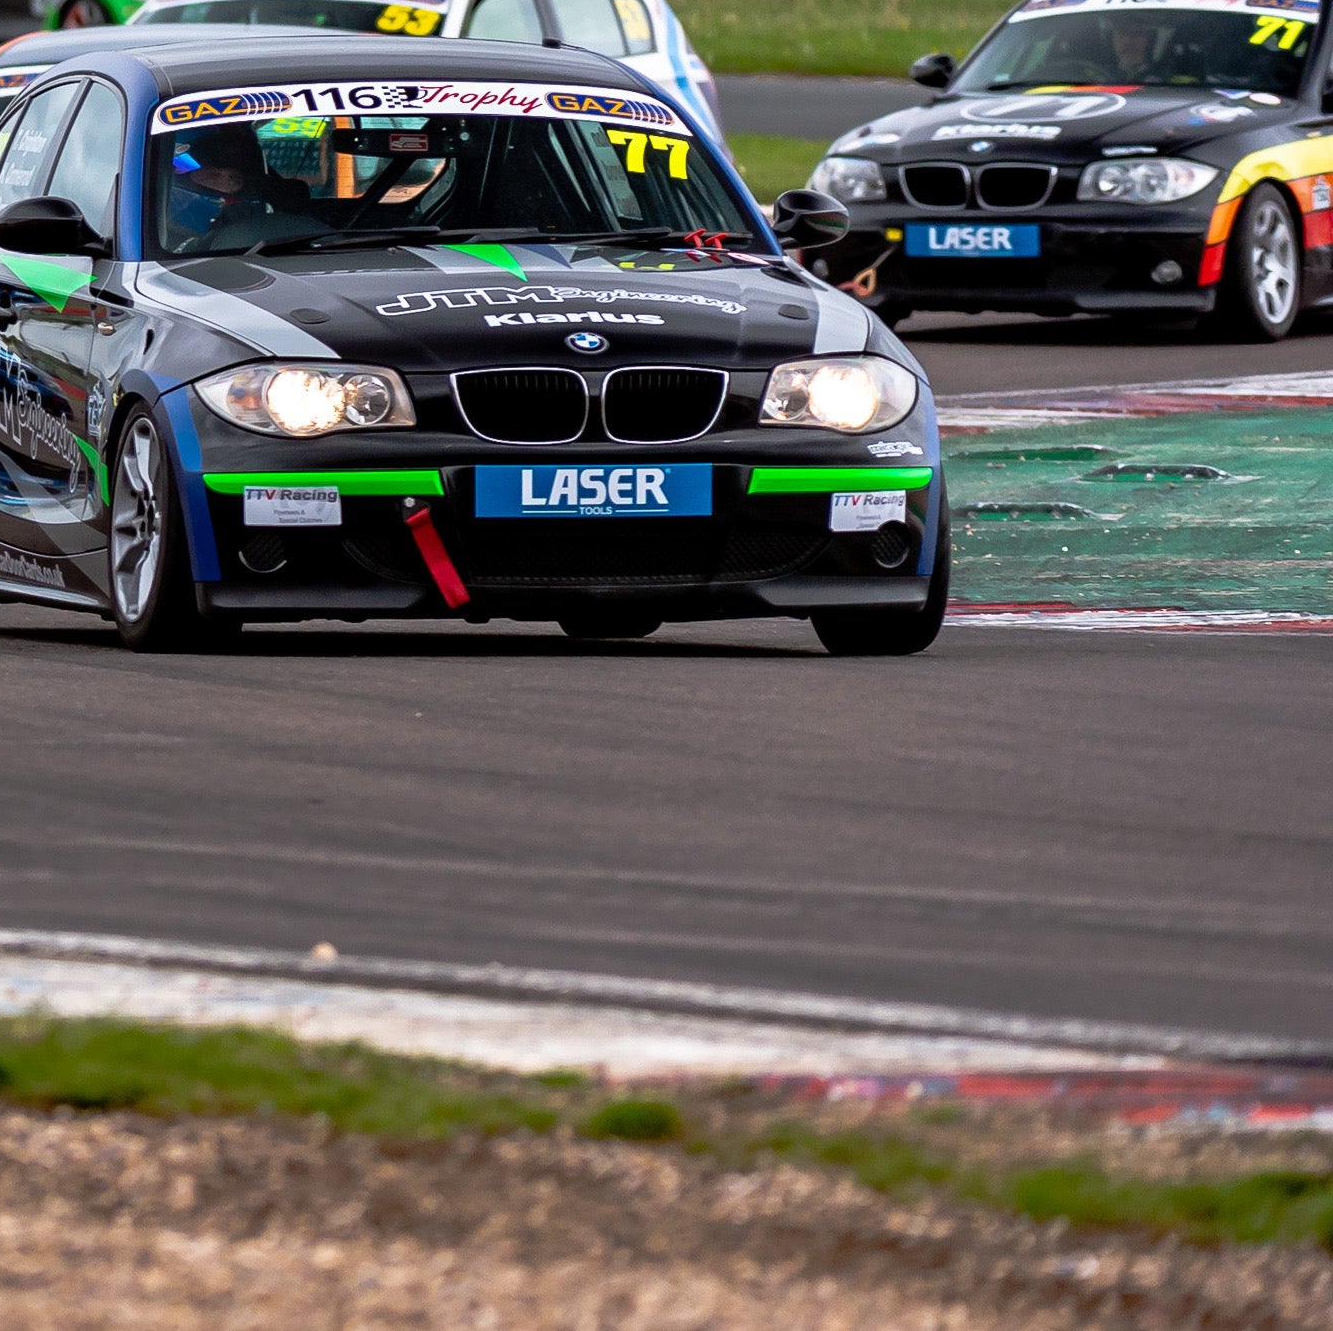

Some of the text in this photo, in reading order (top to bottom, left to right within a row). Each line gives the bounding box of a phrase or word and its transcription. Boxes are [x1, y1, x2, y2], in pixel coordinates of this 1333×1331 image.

[376, 4, 441, 37] 53
[1248, 15, 1305, 50] 71
[165, 97, 247, 124] GAZ
[291, 85, 543, 114] 116 Trophy
[552, 94, 632, 117] GAZ
[607, 129, 690, 180] 77
[928, 227, 1012, 250] LASER
[375, 285, 565, 316] JTM
[483, 311, 665, 328] Klarius
[245, 489, 338, 503] TTV Racing
[521, 468, 669, 506] LASER
[834, 494, 905, 507] TTV Racing
[579, 506, 613, 516] TOOLS
